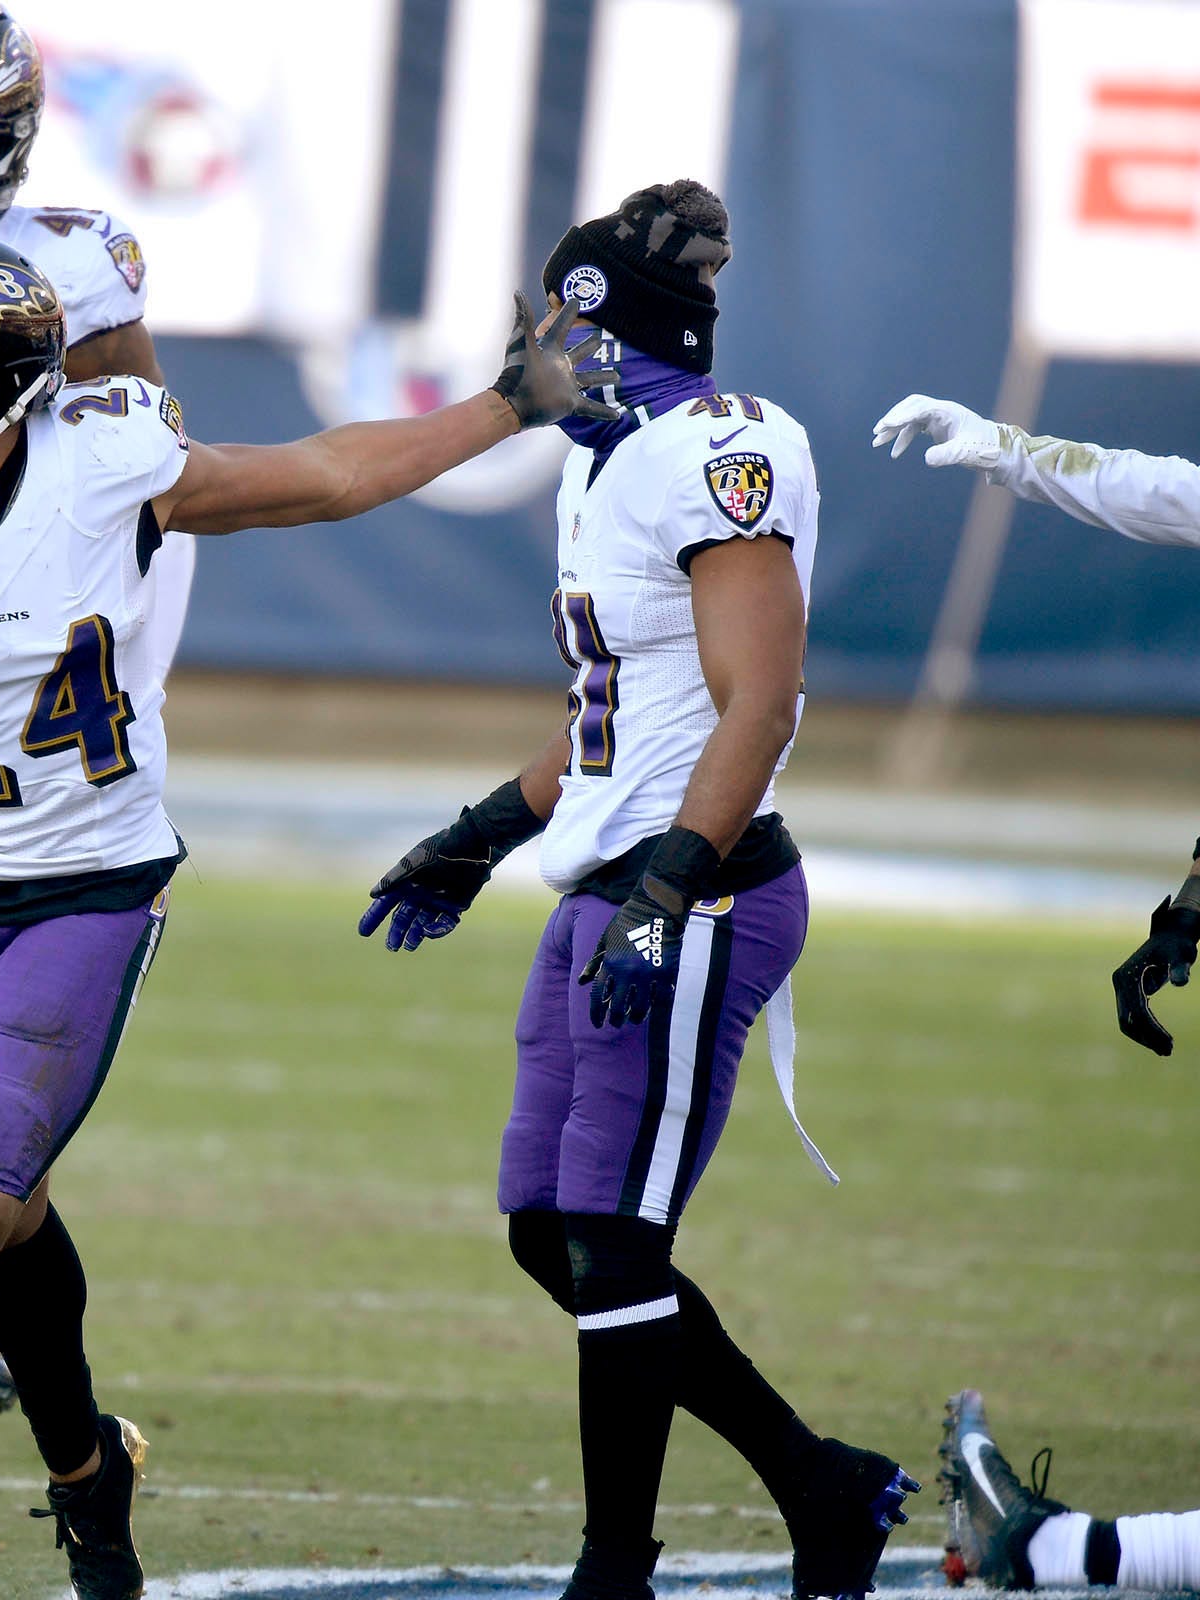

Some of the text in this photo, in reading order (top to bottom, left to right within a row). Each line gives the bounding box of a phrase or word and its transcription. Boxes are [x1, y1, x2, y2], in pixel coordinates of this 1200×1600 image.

[593, 342, 621, 364] 41
[60, 378, 129, 426] 2
[687, 393, 764, 423] 41
[708, 454, 764, 471] RAVENS
[649, 917, 665, 967] adidas
